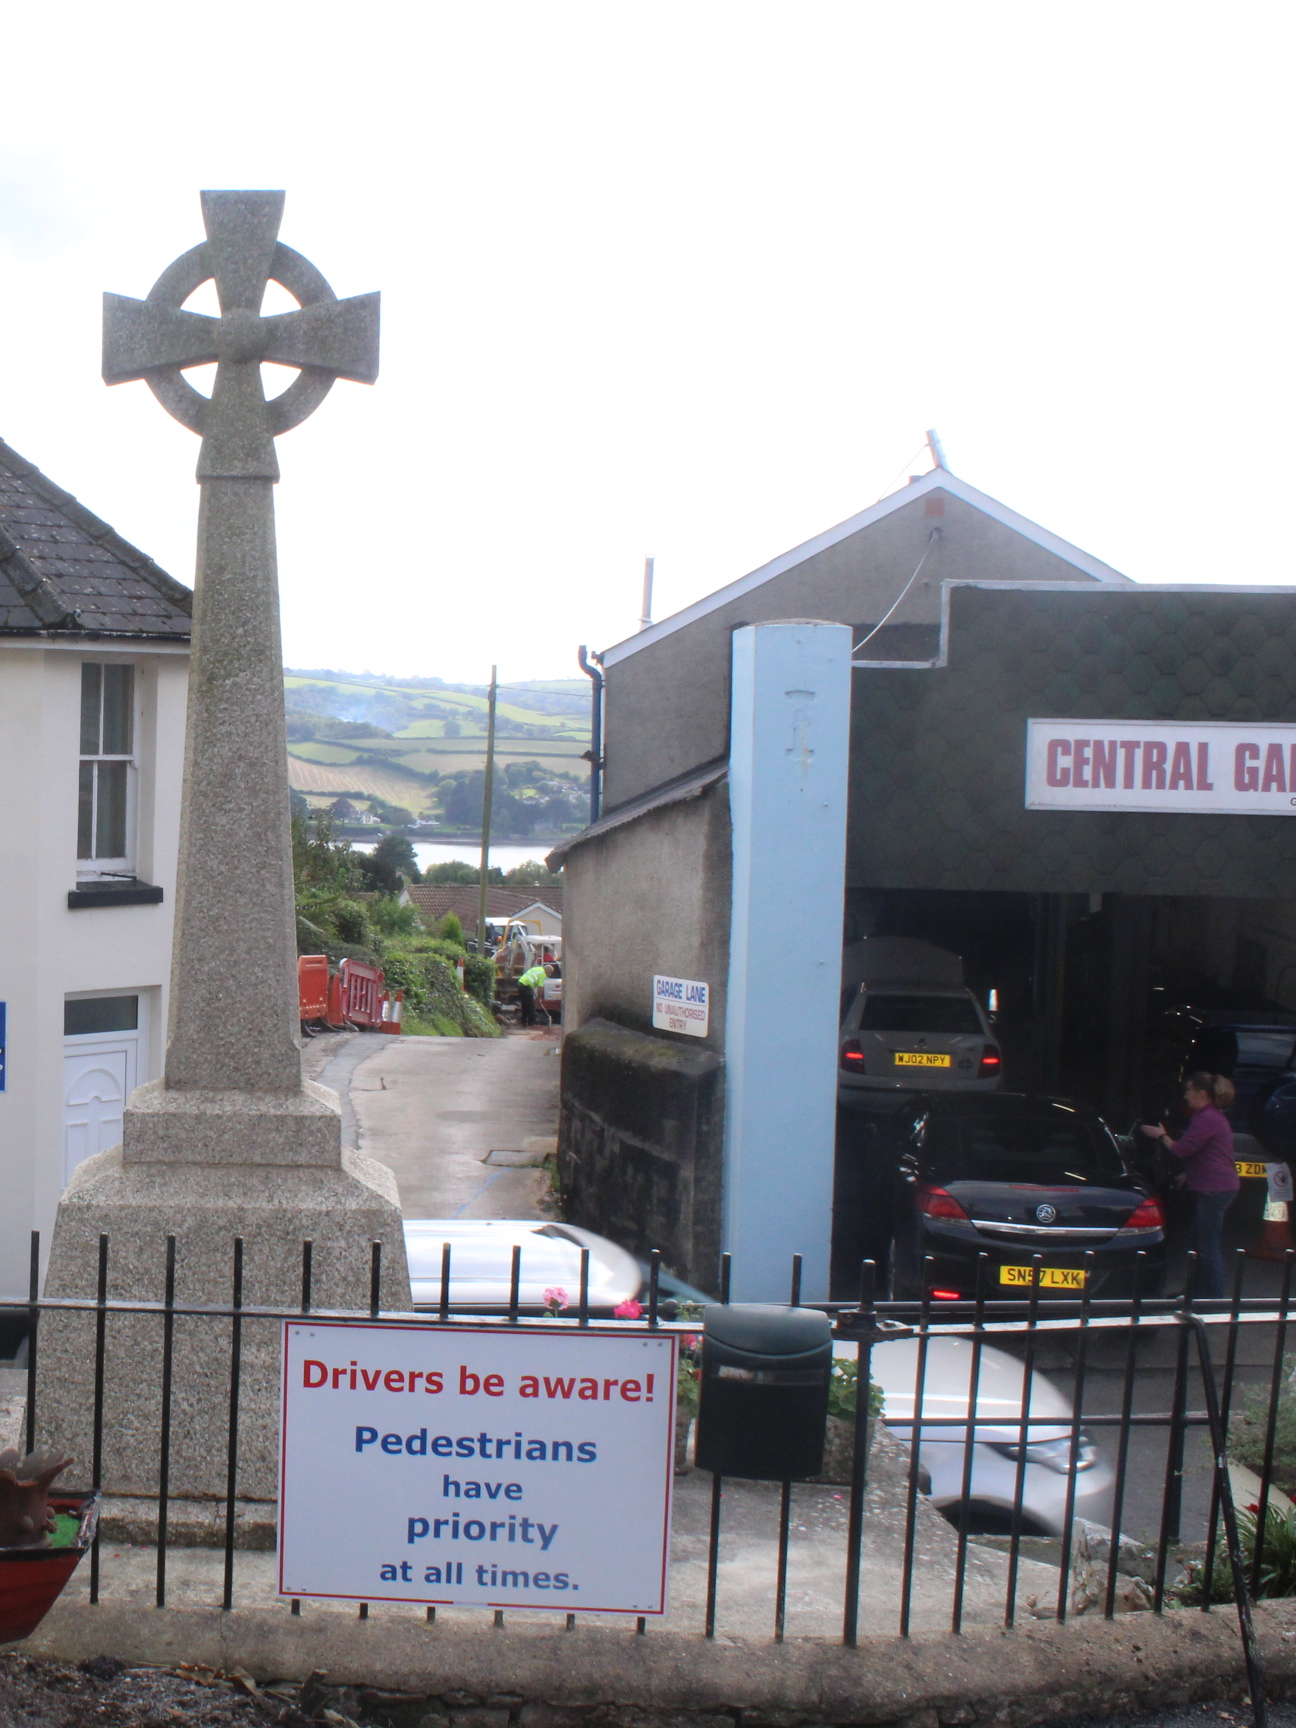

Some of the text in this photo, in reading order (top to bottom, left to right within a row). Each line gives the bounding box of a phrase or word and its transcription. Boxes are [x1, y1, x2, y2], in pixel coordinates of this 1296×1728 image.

[1046, 738, 1296, 793] CENTRAL GA
[656, 979, 706, 1004] GARAGE LANE
[656, 1002, 706, 1021] NO UNAUTHORISED
[669, 1017, 687, 1031] ENTRY
[897, 1054, 945, 1065] WJ02 NPY
[1051, 1270, 1080, 1285] LXK
[302, 1359, 655, 1403] Drivers be aware!
[355, 1425, 598, 1463] Pedestrians
[442, 1474, 524, 1501] have
[406, 1511, 559, 1551] priority
[379, 1560, 580, 1591] at all times.
